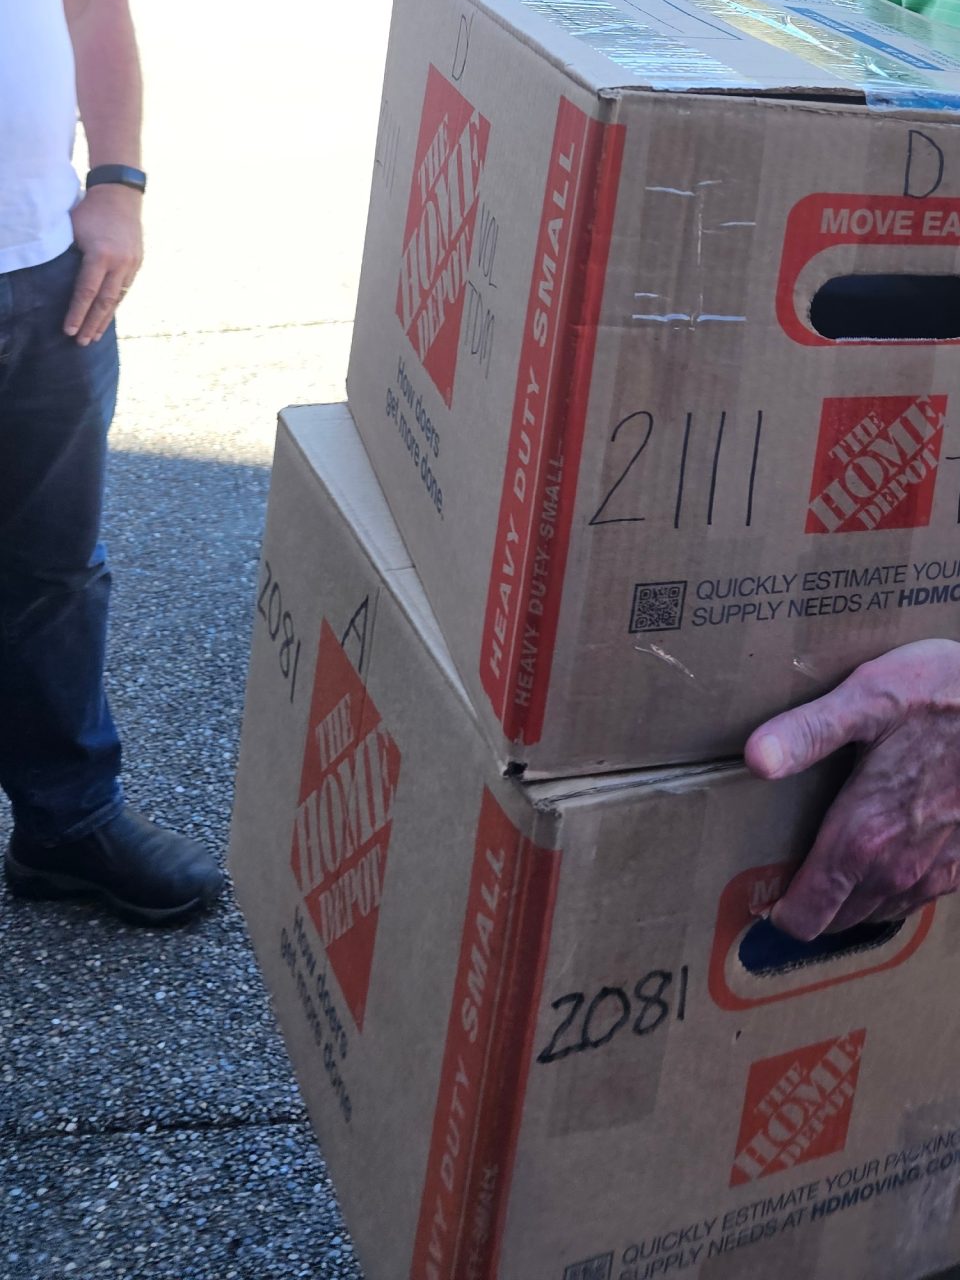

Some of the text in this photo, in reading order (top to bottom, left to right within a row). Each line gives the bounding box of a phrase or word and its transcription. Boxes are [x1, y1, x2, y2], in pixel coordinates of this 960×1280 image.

[417, 111, 450, 207] THE
[903, 129, 945, 199] D
[401, 110, 484, 333] HOME
[820, 207, 914, 237] MOVE
[398, 410, 420, 468] more
[414, 394, 440, 459] doers
[488, 514, 520, 680] HEAVY
[513, 366, 541, 503] DUTY
[533, 142, 575, 348] SMALL
[827, 410, 886, 465] THE
[588, 410, 764, 529] 2111
[808, 394, 946, 534] HOME
[856, 443, 939, 531] DEPOT
[513, 621, 541, 707] HEAVY
[528, 546, 551, 617] DUTY
[540, 454, 565, 540] SMALL
[691, 600, 784, 627] SUPPLY
[787, 593, 863, 619] NEEDS
[866, 590, 895, 611] AT
[695, 573, 798, 601] QUICKLY
[802, 564, 908, 592] ESTIMATE
[340, 593, 369, 675] A
[315, 692, 354, 772] THE
[296, 726, 396, 896] HOME
[440, 1054, 469, 1192] DUTY
[461, 847, 505, 1044] SMALL
[536, 965, 689, 1065] 2081
[734, 1034, 862, 1181] HOME
[753, 1060, 808, 1118] THE
[621, 1217, 719, 1266] QUICKLY
[721, 1181, 822, 1233] ESTIMATE
[824, 1158, 881, 1193] YOUR
[706, 1217, 779, 1259] NEEDS
[781, 1206, 810, 1233] AT
